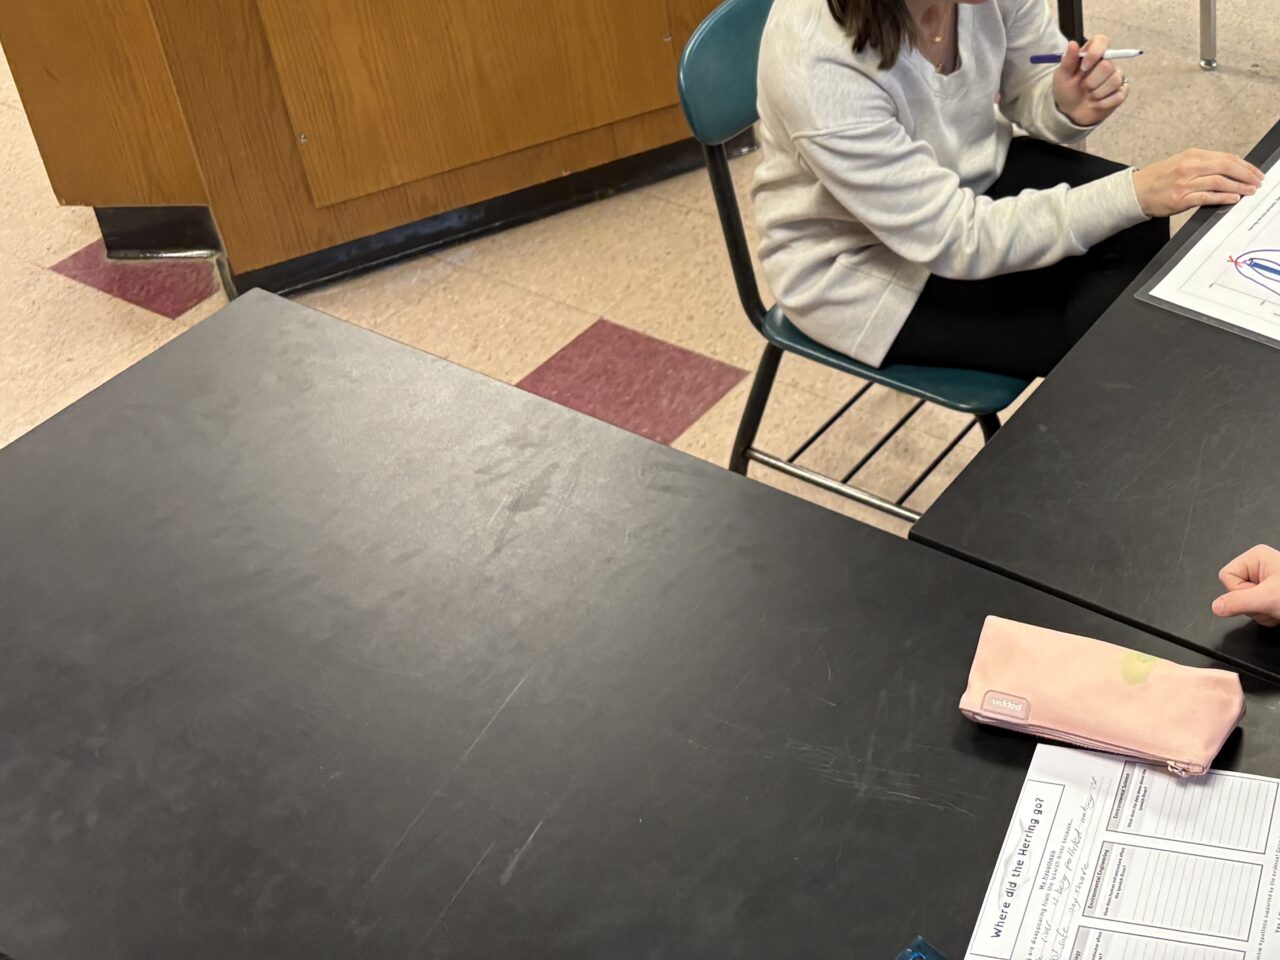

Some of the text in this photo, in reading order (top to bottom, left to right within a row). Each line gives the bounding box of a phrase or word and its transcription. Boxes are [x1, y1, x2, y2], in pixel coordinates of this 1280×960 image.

[991, 698, 1023, 712] poppin
[1113, 773, 1130, 819] Environmental Science
[990, 797, 1046, 940] Where did the Herring go?
[1088, 849, 1110, 909] Environmental Engineering
[1030, 908, 1047, 945] disappearing
